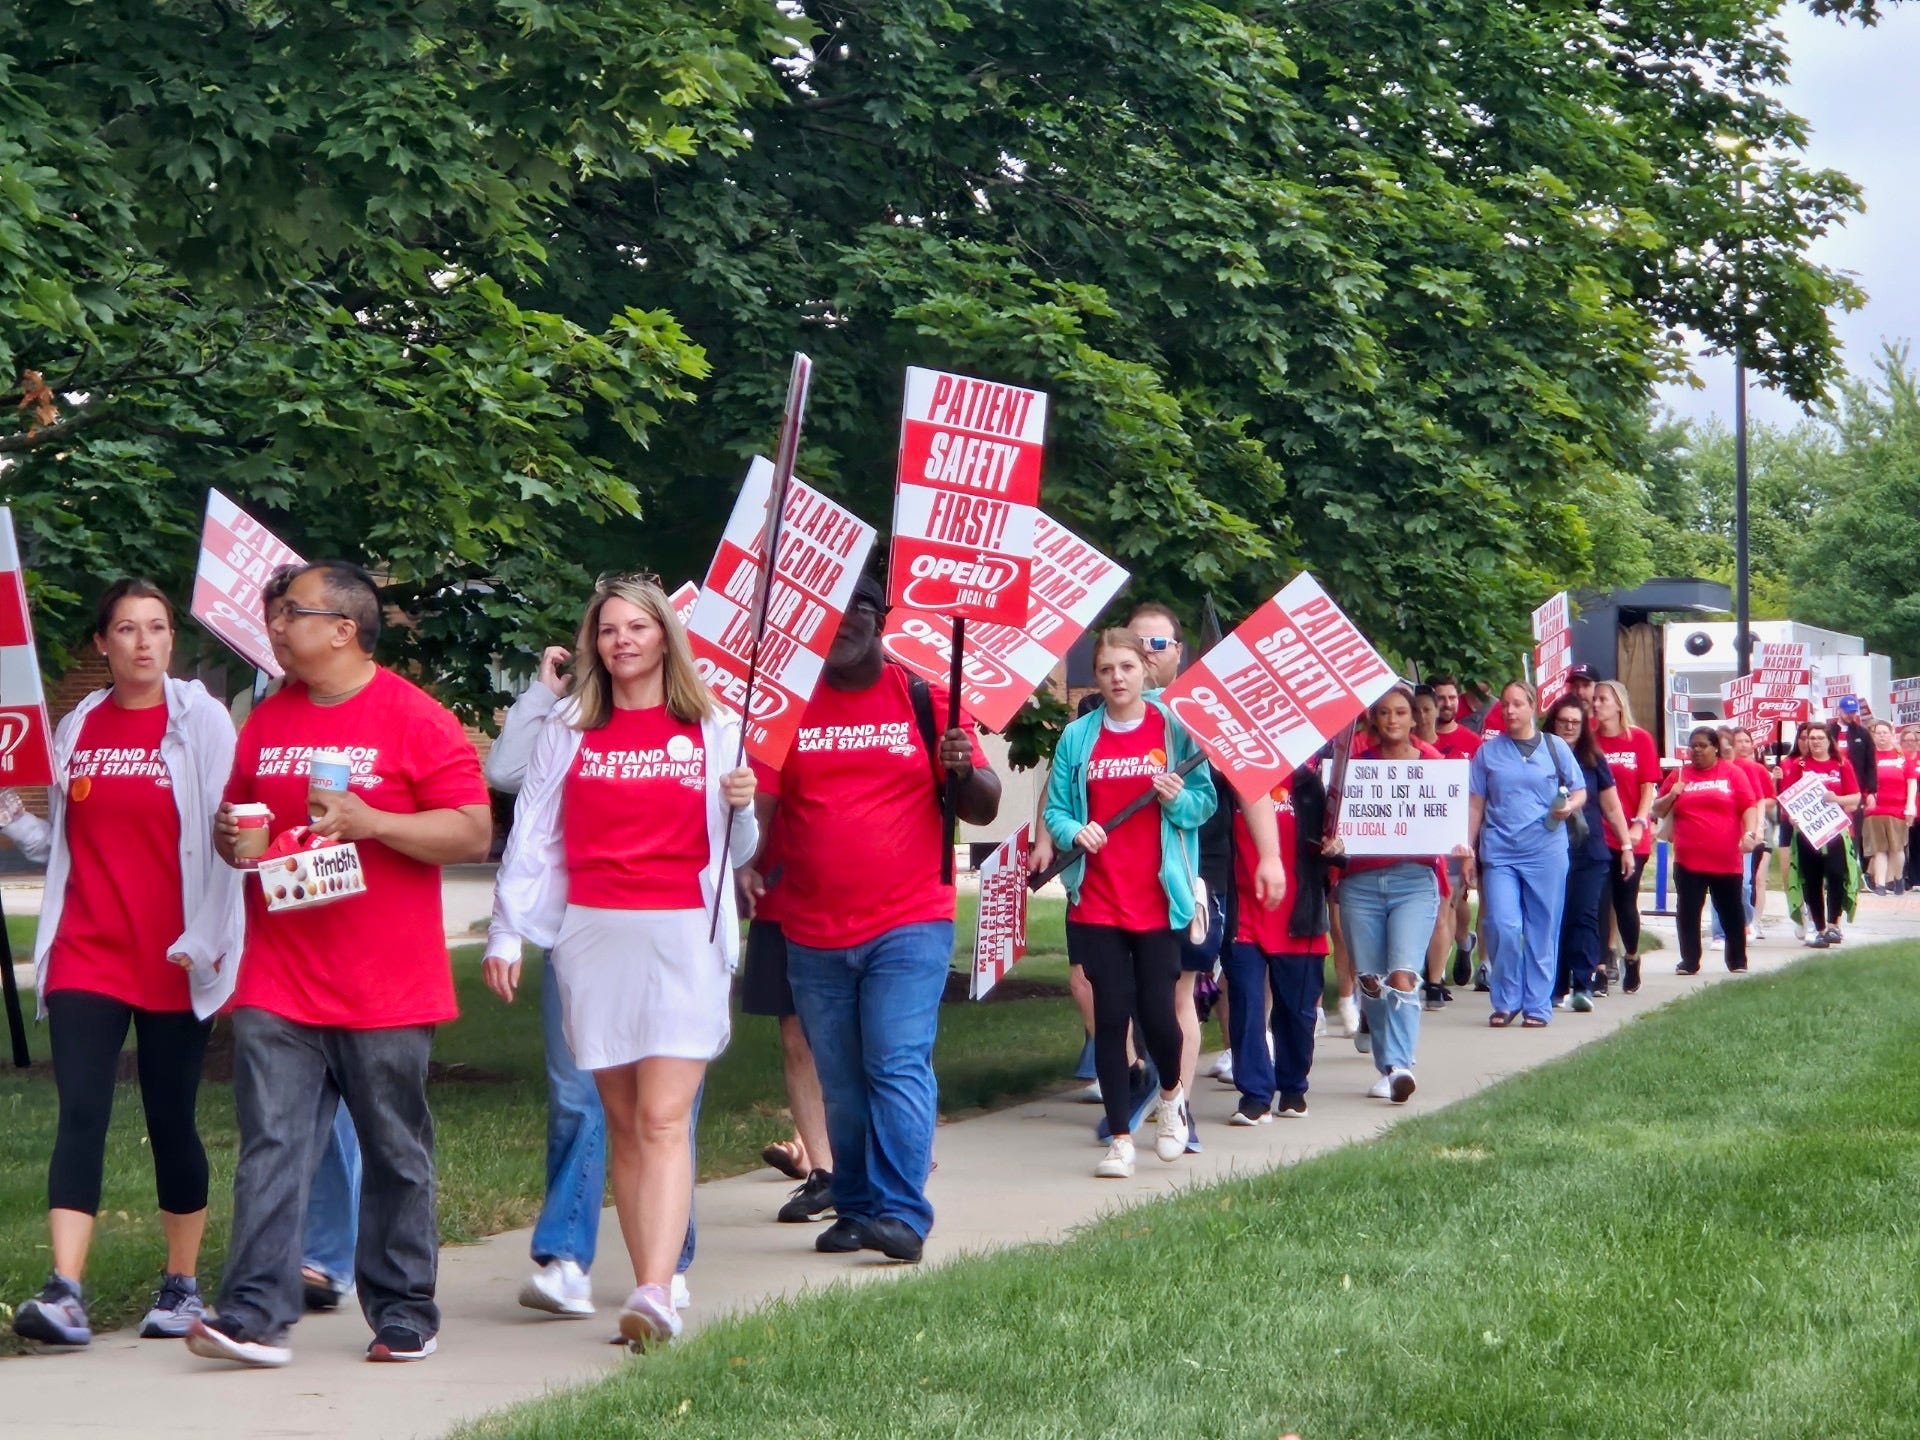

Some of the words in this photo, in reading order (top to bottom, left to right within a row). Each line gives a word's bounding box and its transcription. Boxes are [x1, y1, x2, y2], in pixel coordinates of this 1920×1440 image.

[926, 374, 1036, 438] PATIENT
[924, 431, 1021, 493] SAFETY
[764, 481, 864, 558] CLAREN
[924, 491, 1011, 550] FIRST!
[1032, 516, 1114, 586] CLAREN
[910, 554, 1004, 588] OPEIU
[1029, 553, 1087, 610] COMB
[956, 588, 983, 606] LOCAL
[984, 592, 998, 609] 40
[794, 595, 826, 644] TO
[1022, 606, 1064, 641] TO
[1289, 595, 1388, 688] PATIENT
[1763, 643, 1804, 656] MCLAREN
[1254, 626, 1348, 711] SAFETY
[1763, 656, 1803, 669] MACOMB
[1222, 662, 1308, 740] FIRST!
[1758, 701, 1796, 711] OPEIU
[797, 727, 822, 739] WE
[825, 724, 875, 738] STAND
[880, 721, 909, 735] FOR
[1190, 686, 1266, 765] OPEIU
[797, 738, 833, 751] SAFE
[837, 733, 908, 750] STAFFING
[93, 748, 146, 762] STAND
[260, 747, 282, 760] WE
[582, 747, 602, 763] WE
[606, 749, 665, 765] STAND
[1098, 756, 1140, 769] STAND
[1211, 735, 1235, 760] LOCAL
[1231, 755, 1247, 772] 40
[101, 762, 171, 777] STAFFIN
[256, 761, 290, 776] SAFE
[294, 761, 373, 775] STNG
[579, 762, 616, 778] SAFE
[620, 762, 702, 778] STAFFING
[1087, 769, 1104, 779] AFE
[1354, 765, 1379, 780] SIGN
[1387, 765, 1397, 780] IS
[1407, 765, 1424, 780] BIG
[1343, 785, 1364, 799] UGH
[1371, 784, 1383, 799] TO
[1391, 784, 1411, 799] LIST
[1418, 784, 1437, 799] ALL
[1448, 783, 1460, 798] OF
[1788, 784, 1825, 815] PATIENTS
[1349, 803, 1393, 818] REASONS
[1399, 801, 1416, 818] I'M
[1424, 803, 1448, 818] HERE
[1802, 799, 1829, 822] OVER
[1337, 822, 1353, 836] EIU
[1356, 822, 1387, 836] LOCAL
[1393, 822, 1408, 836] 40
[1805, 807, 1840, 836] PROFITS
[312, 847, 358, 878] timbits
